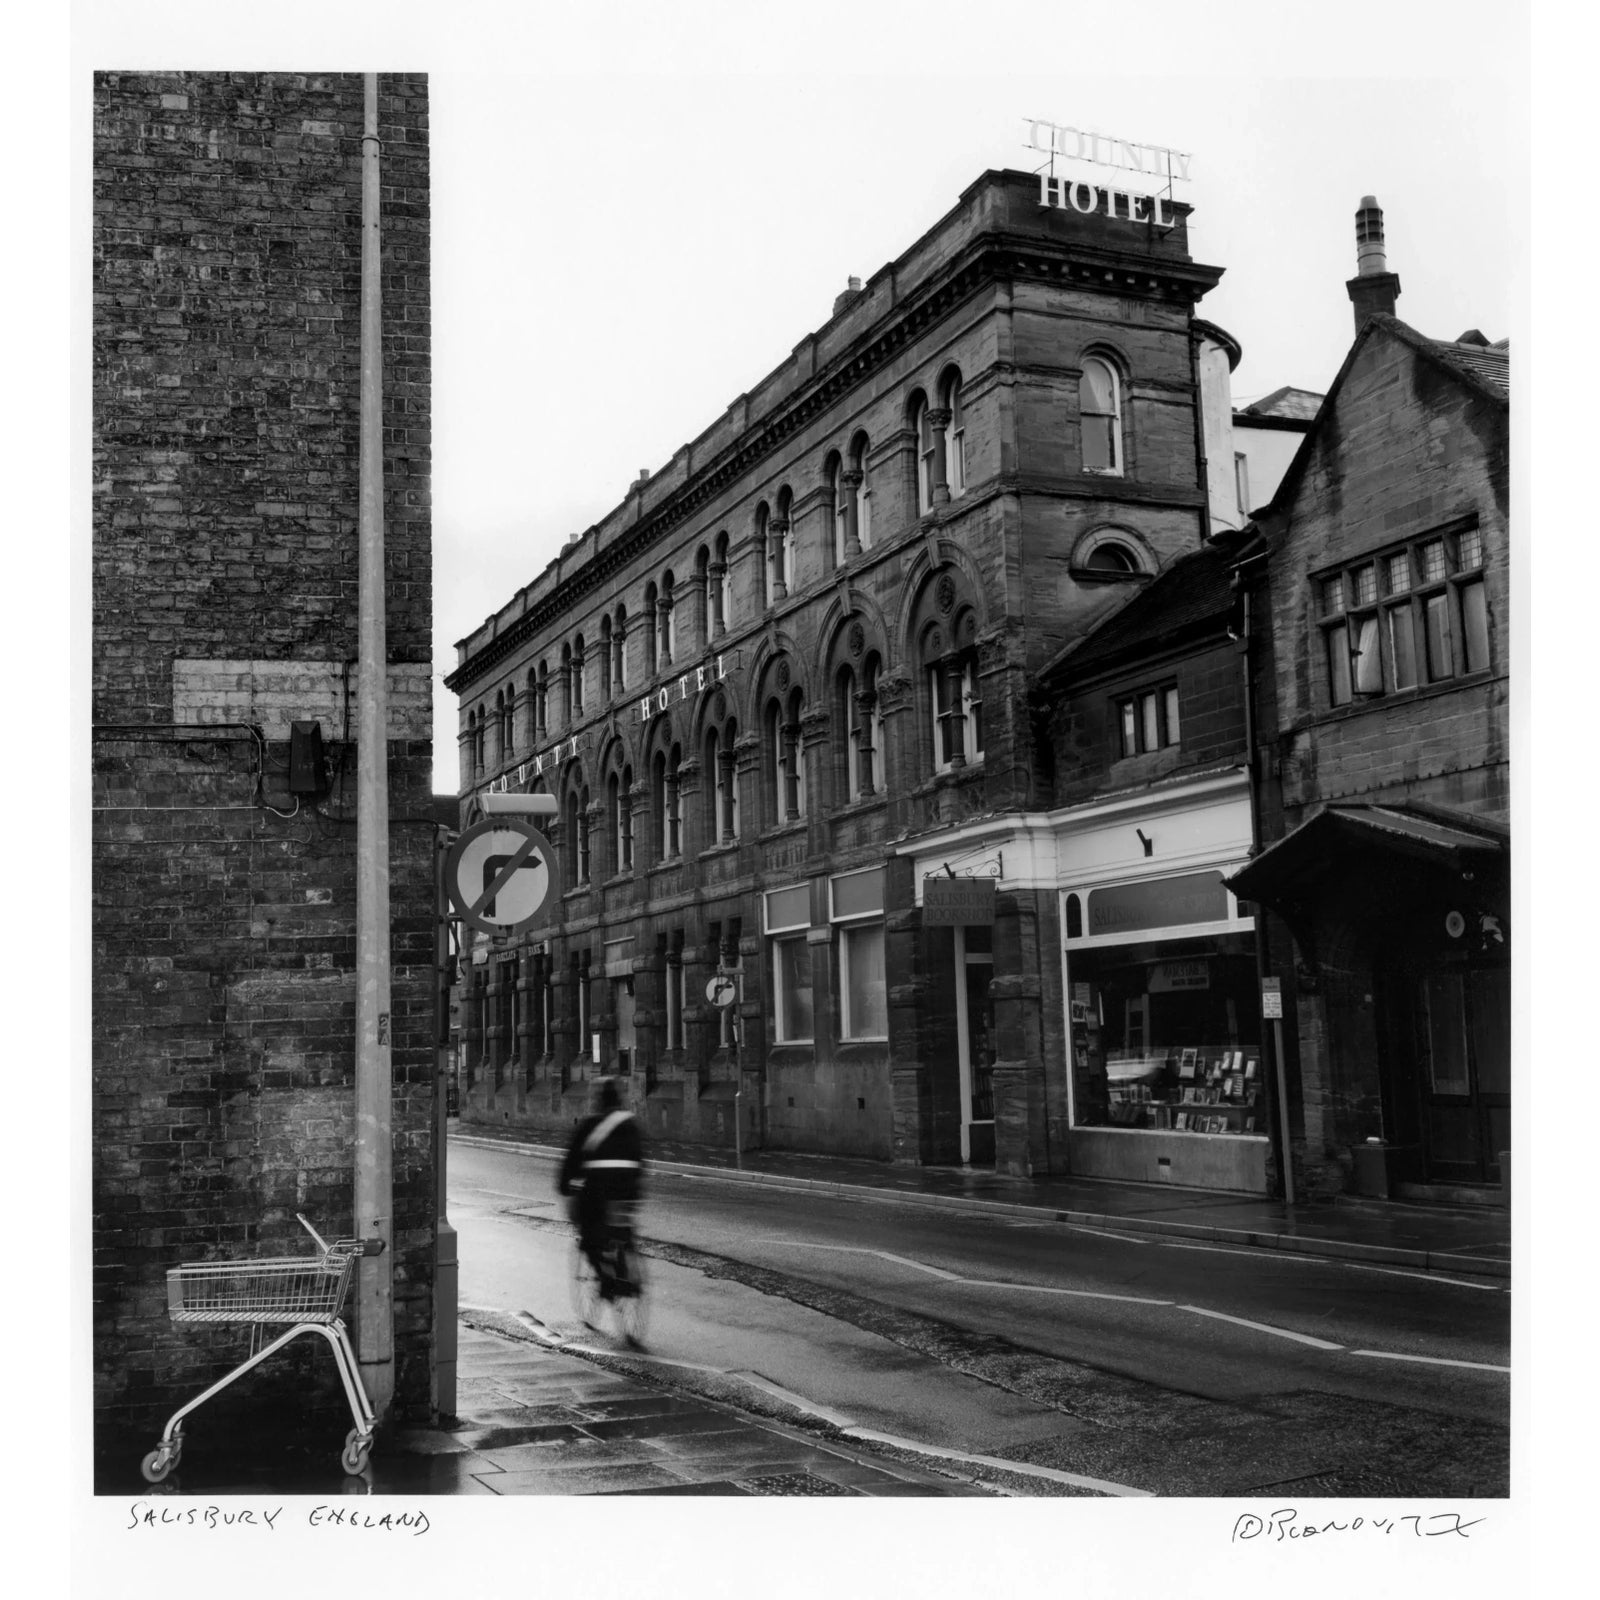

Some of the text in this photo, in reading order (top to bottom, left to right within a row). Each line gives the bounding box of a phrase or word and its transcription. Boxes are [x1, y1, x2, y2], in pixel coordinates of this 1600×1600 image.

[1030, 120, 1192, 182] COUNTY
[1038, 173, 1175, 228] HOTEL
[490, 655, 727, 794] COUNTY HOTEL
[925, 892, 991, 906] SALISBURY
[926, 907, 993, 921] BOOKSHOP
[127, 1501, 430, 1536] SALISBURY ENGLAND
